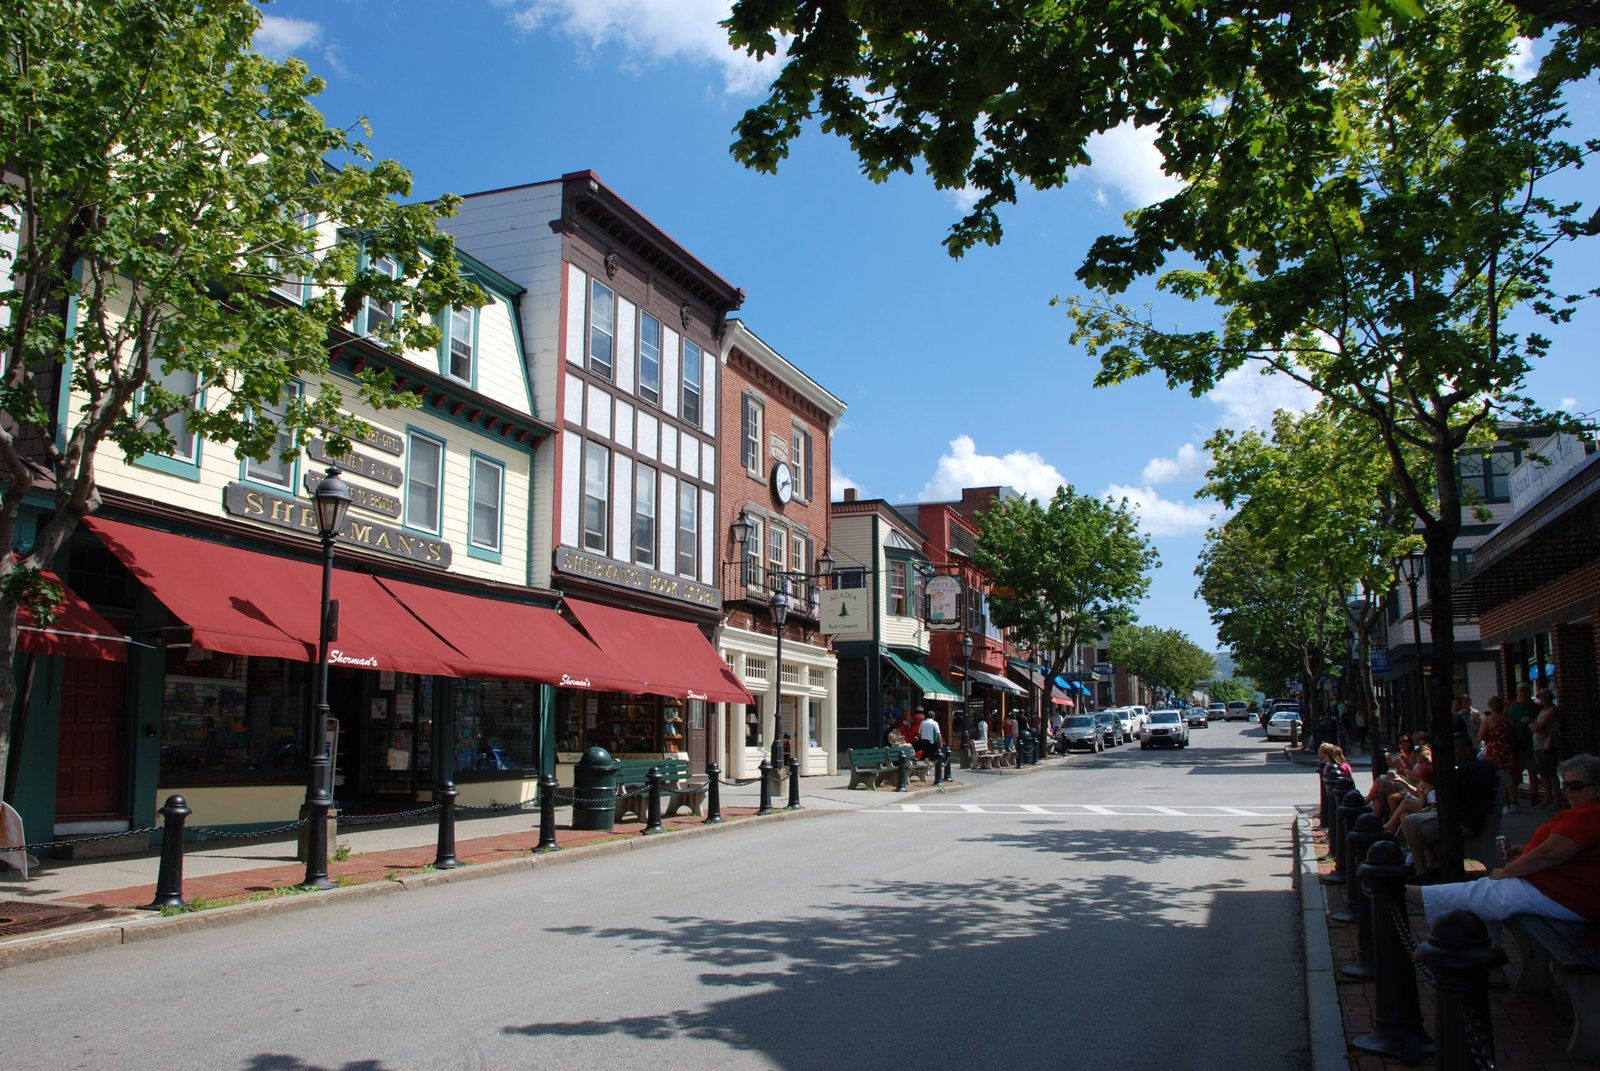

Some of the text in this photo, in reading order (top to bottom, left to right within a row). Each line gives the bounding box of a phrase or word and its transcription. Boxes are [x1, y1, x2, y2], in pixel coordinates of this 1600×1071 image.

[244, 493, 442, 562] SHEMAN'S
[563, 552, 718, 605] SHERMAN'S BOOK STORE
[830, 592, 857, 602] ACADIA
[327, 649, 378, 667] Sherman's
[559, 673, 592, 688] Sherman's
